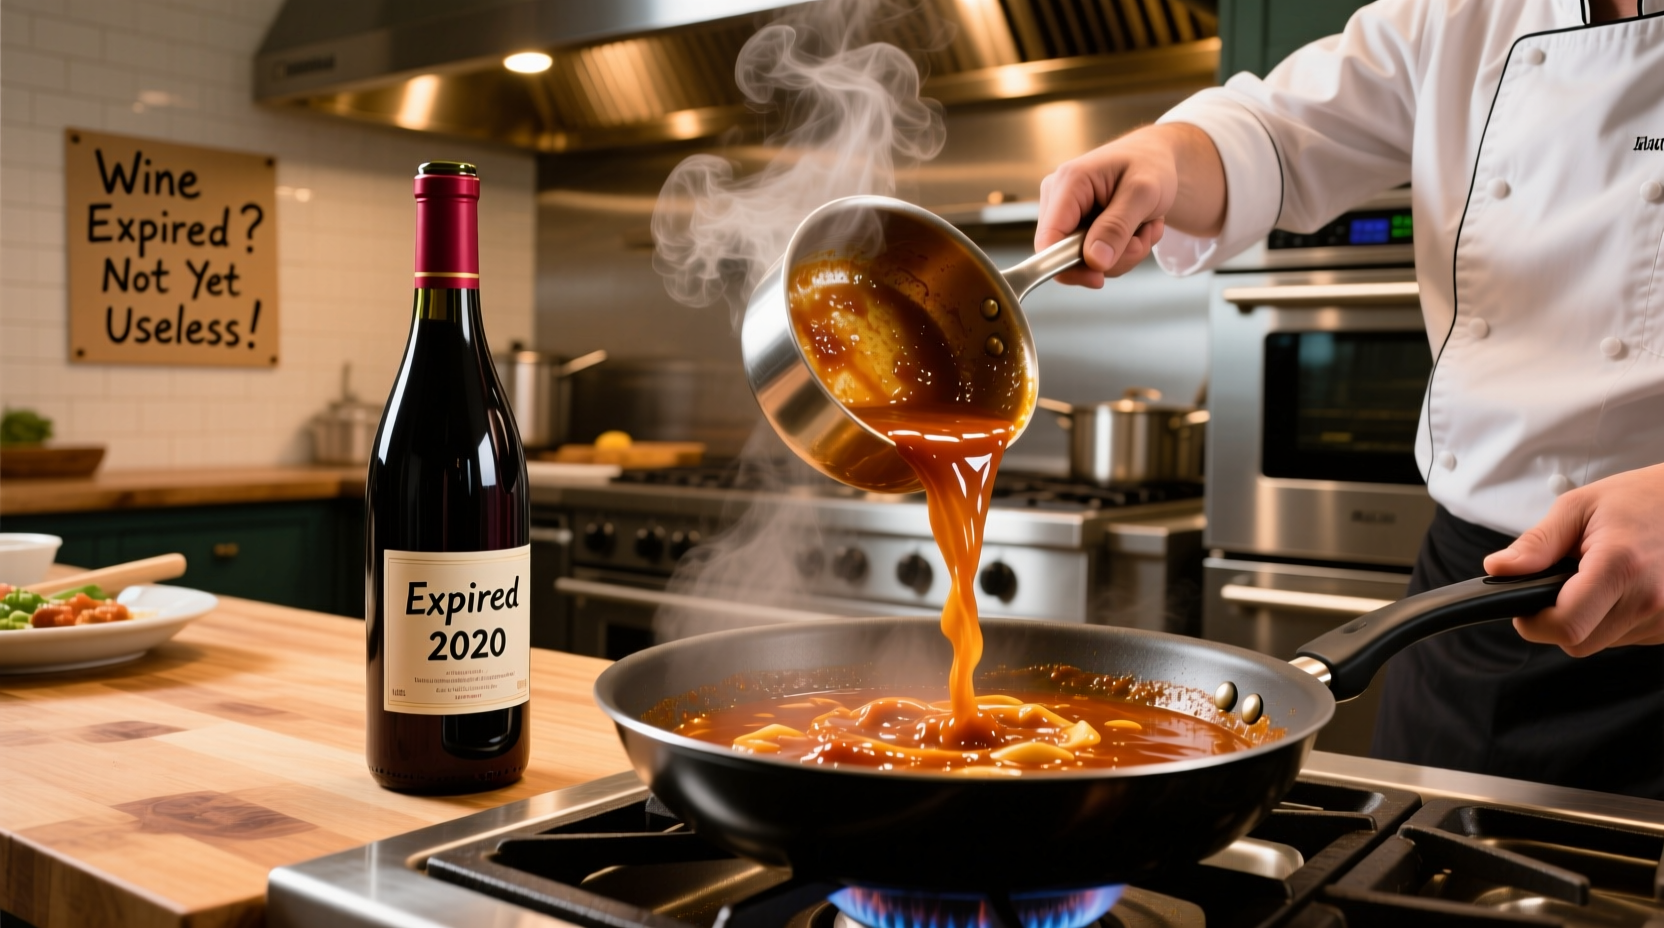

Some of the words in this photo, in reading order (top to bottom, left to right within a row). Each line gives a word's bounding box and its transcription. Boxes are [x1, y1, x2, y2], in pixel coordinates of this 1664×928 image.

[95, 148, 201, 199] Wine
[102, 256, 170, 294] Not
[186, 258, 241, 300] Yet
[106, 299, 262, 350] Useless!
[406, 575, 519, 626] Expired
[427, 627, 506, 661] 2020
